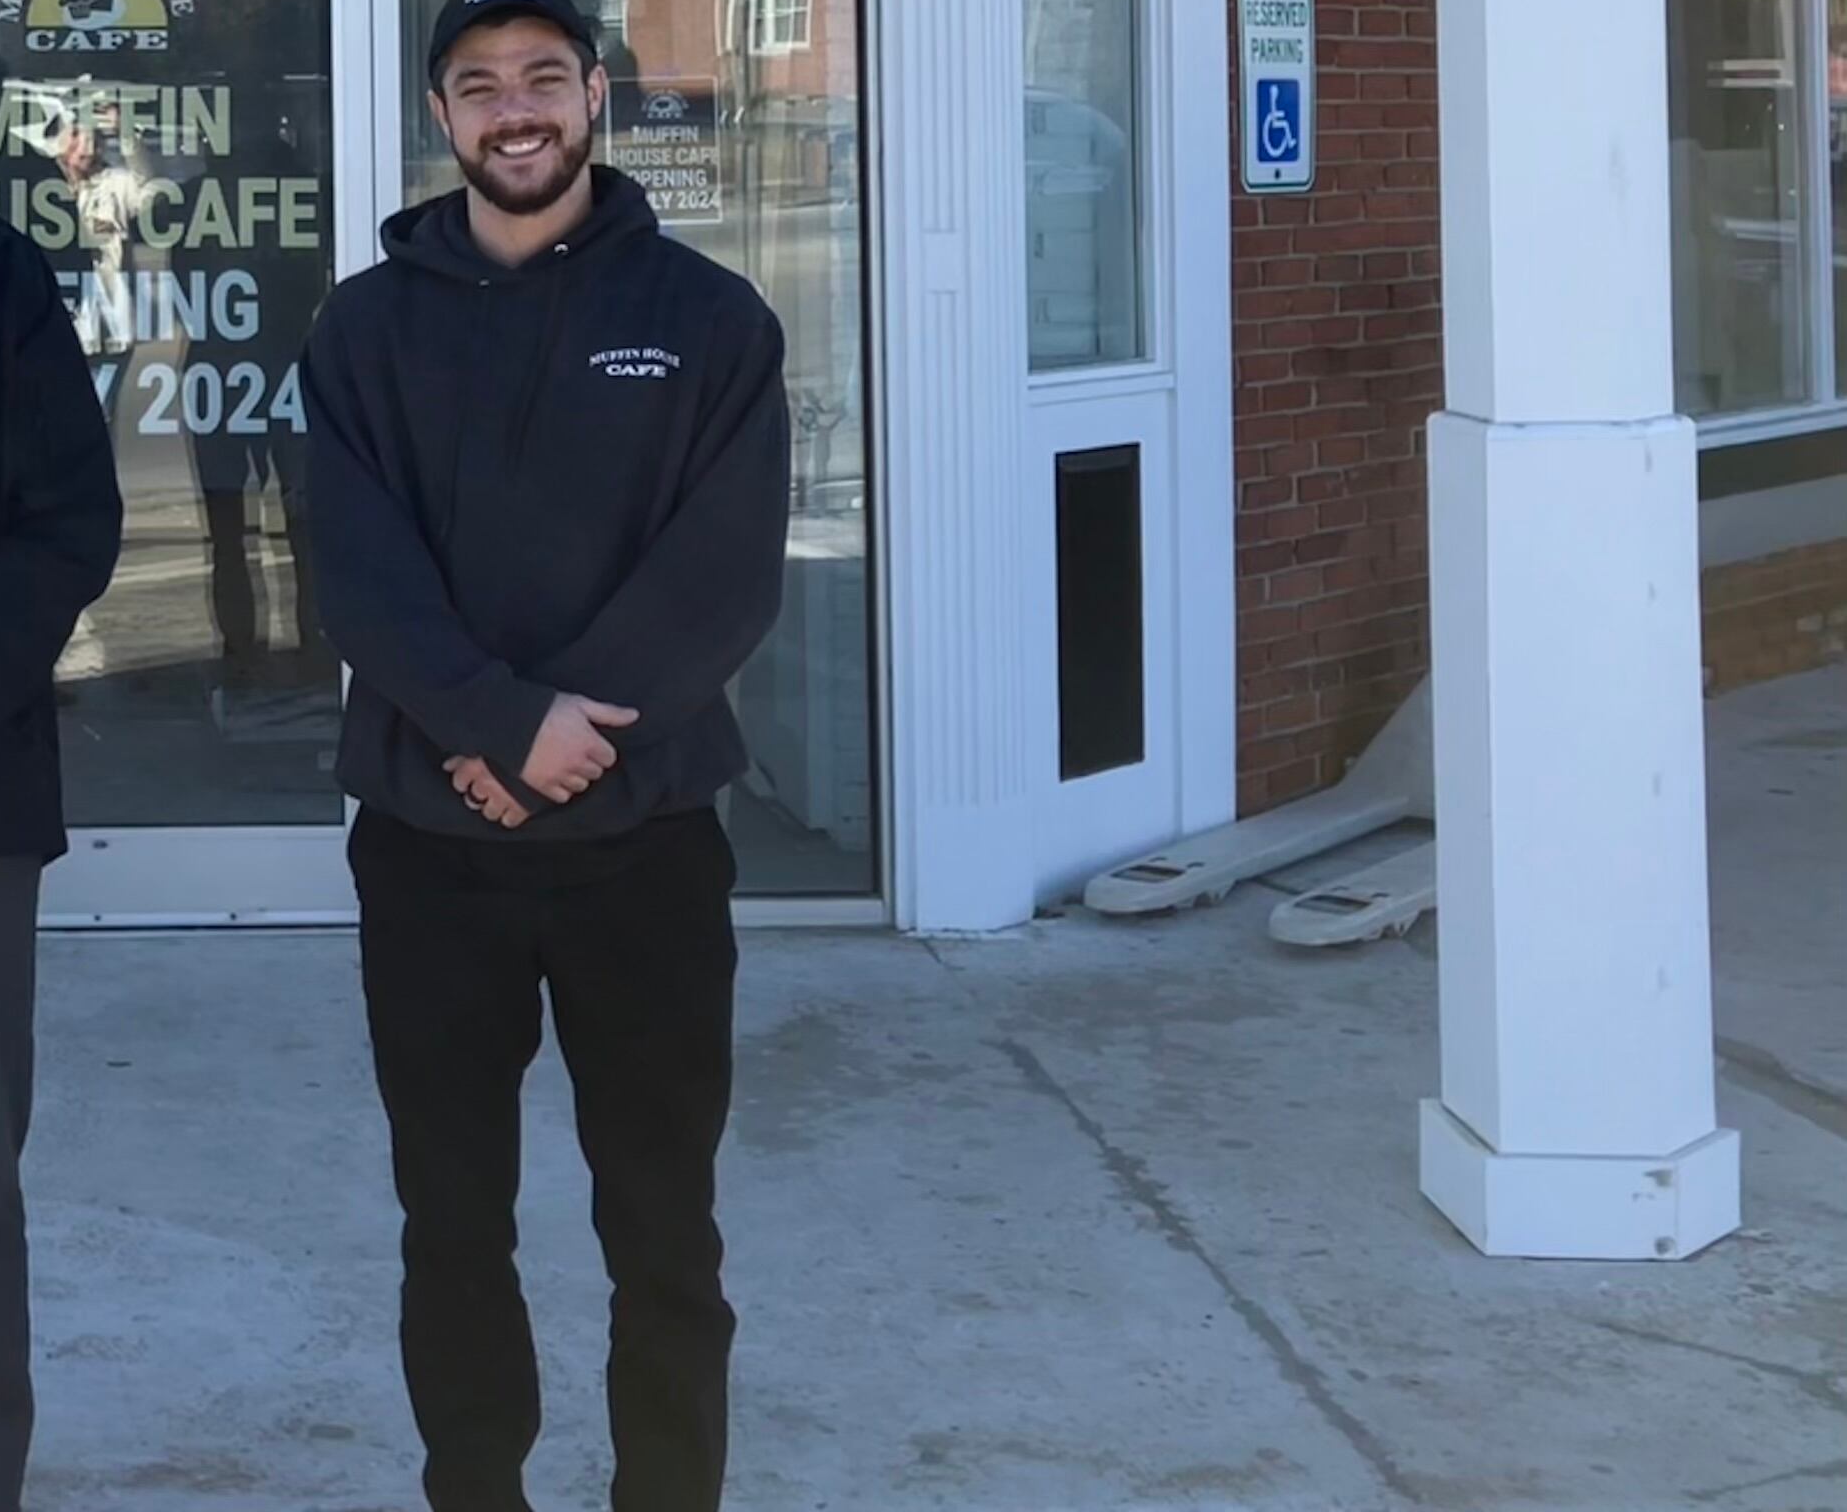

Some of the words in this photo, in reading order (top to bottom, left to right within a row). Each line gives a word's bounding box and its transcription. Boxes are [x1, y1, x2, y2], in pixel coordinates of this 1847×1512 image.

[1246, 0, 1307, 27] RESERVED
[25, 29, 169, 52] CAFE
[1251, 37, 1304, 64] PARKING
[631, 126, 700, 143] MUFFIN
[613, 147, 674, 166] HOUSE
[137, 176, 320, 249] CAFE
[605, 364, 666, 378] CAFE
[137, 361, 309, 434] 2024
